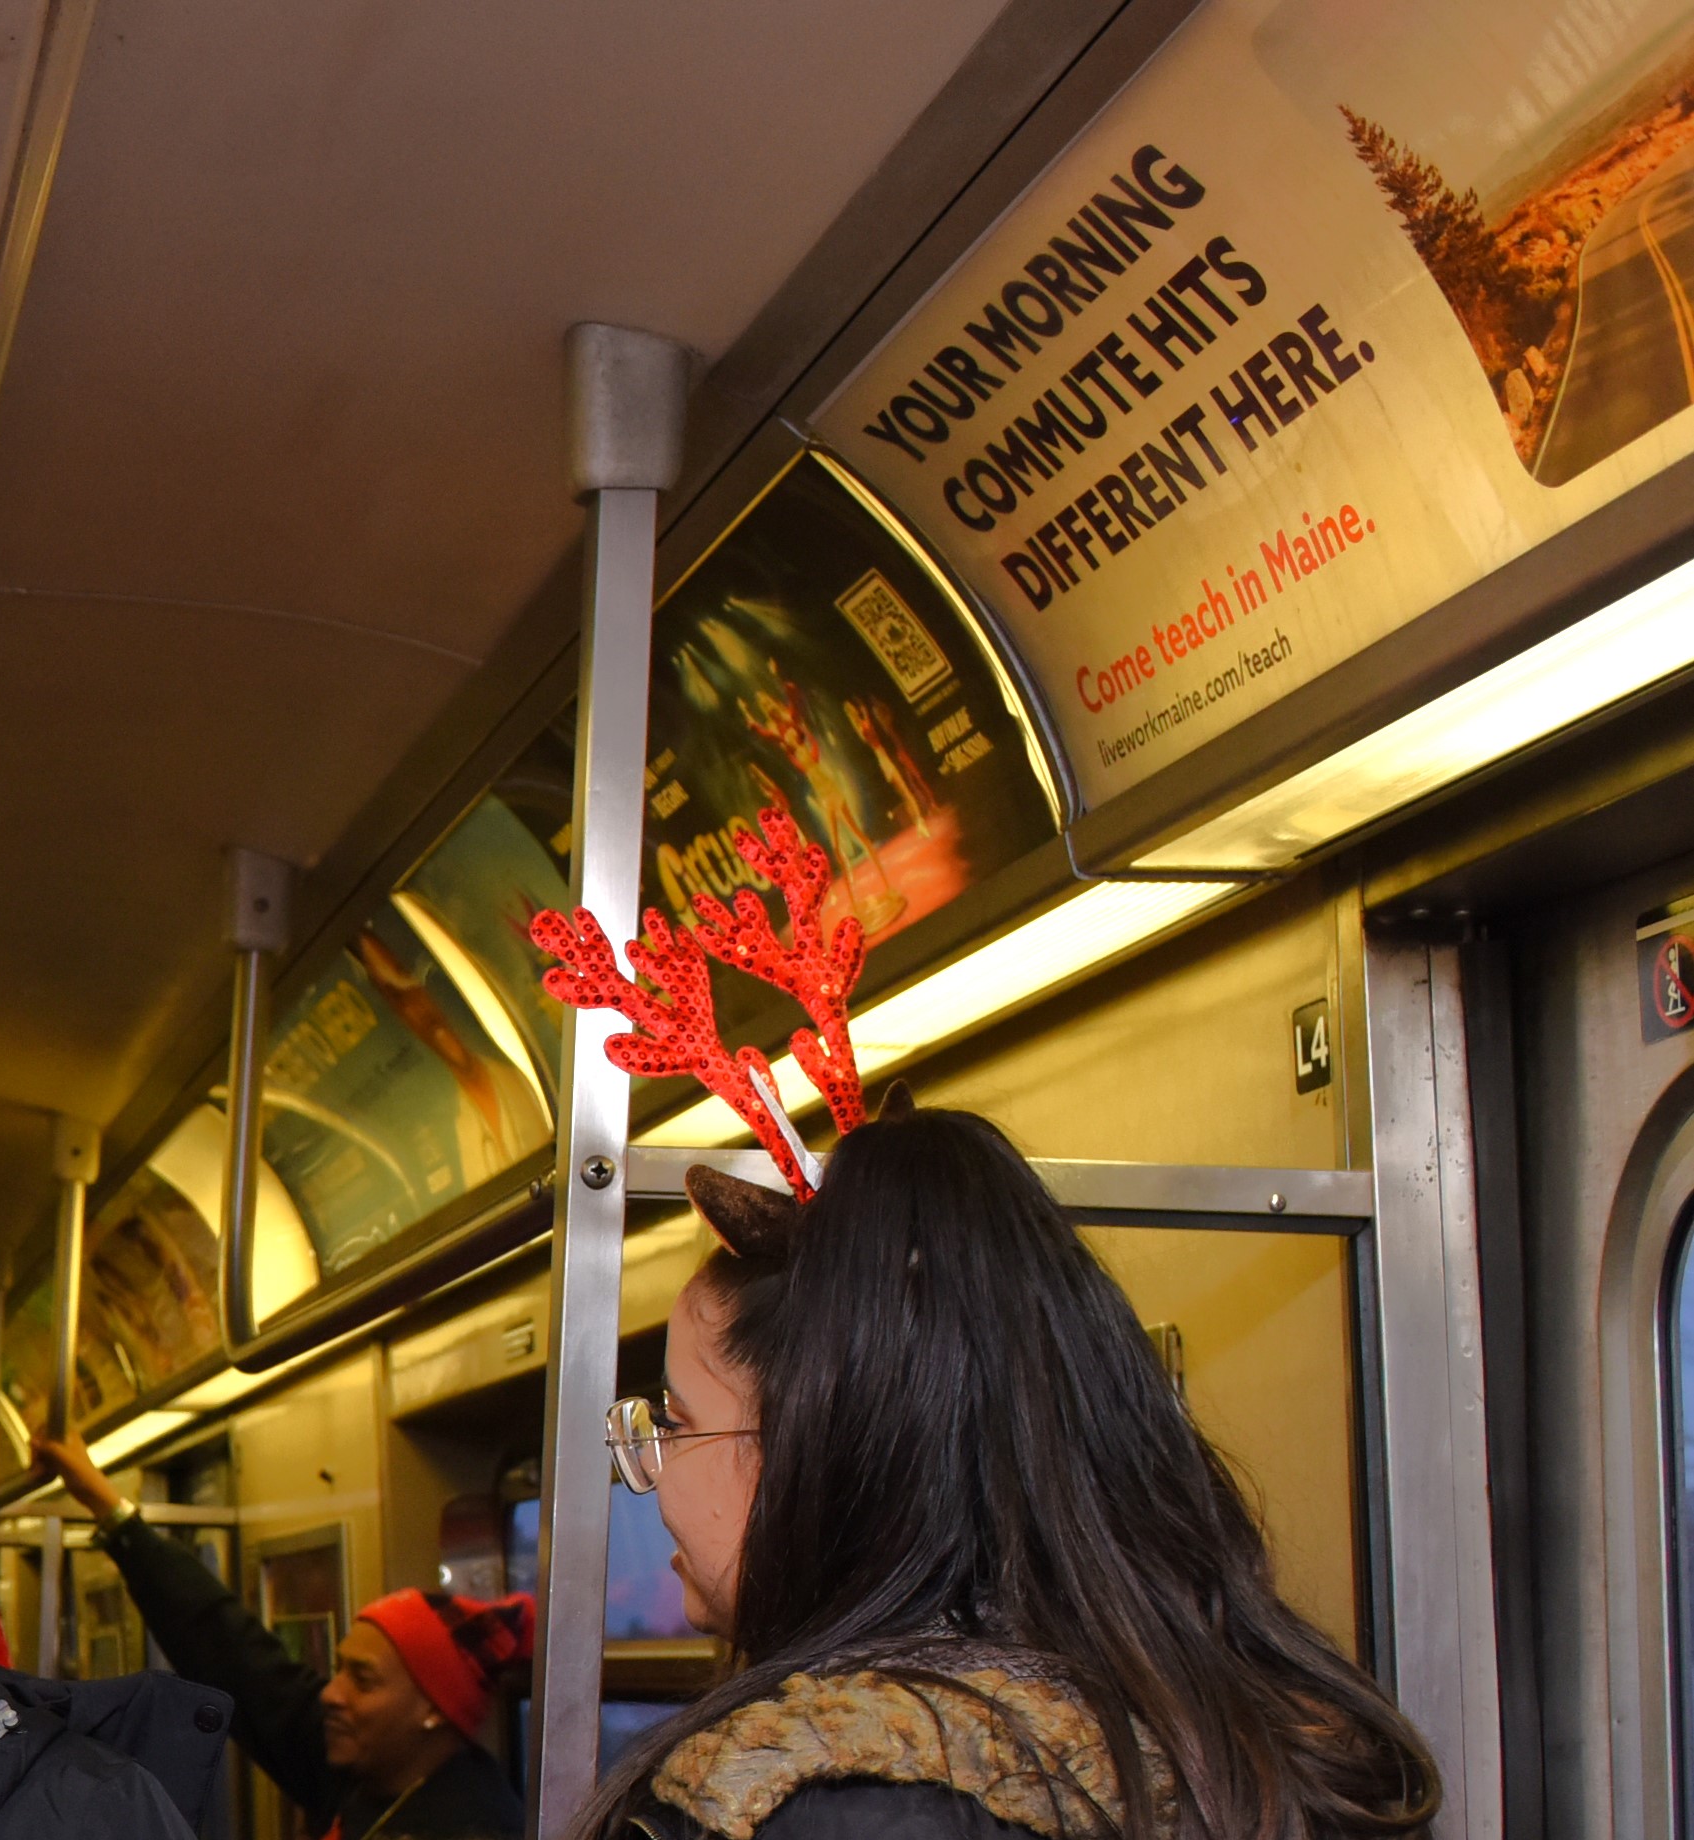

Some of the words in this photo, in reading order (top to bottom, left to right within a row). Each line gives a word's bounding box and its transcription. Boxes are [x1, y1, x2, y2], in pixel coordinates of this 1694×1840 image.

[863, 345, 1006, 463] YOUR
[963, 144, 1206, 374] MORNING
[943, 332, 1164, 533] COMMUTE
[1125, 235, 1267, 372] HITS
[1000, 402, 1228, 612] DIFFERENT
[1208, 303, 1376, 453] HERE.
[1075, 644, 1156, 714] Come
[1153, 578, 1235, 666] teach
[1225, 564, 1269, 616] in
[1258, 503, 1376, 594] Maine.
[1097, 627, 1293, 768] liveworkmaine.com/teach
[1295, 1015, 1330, 1077] L4
